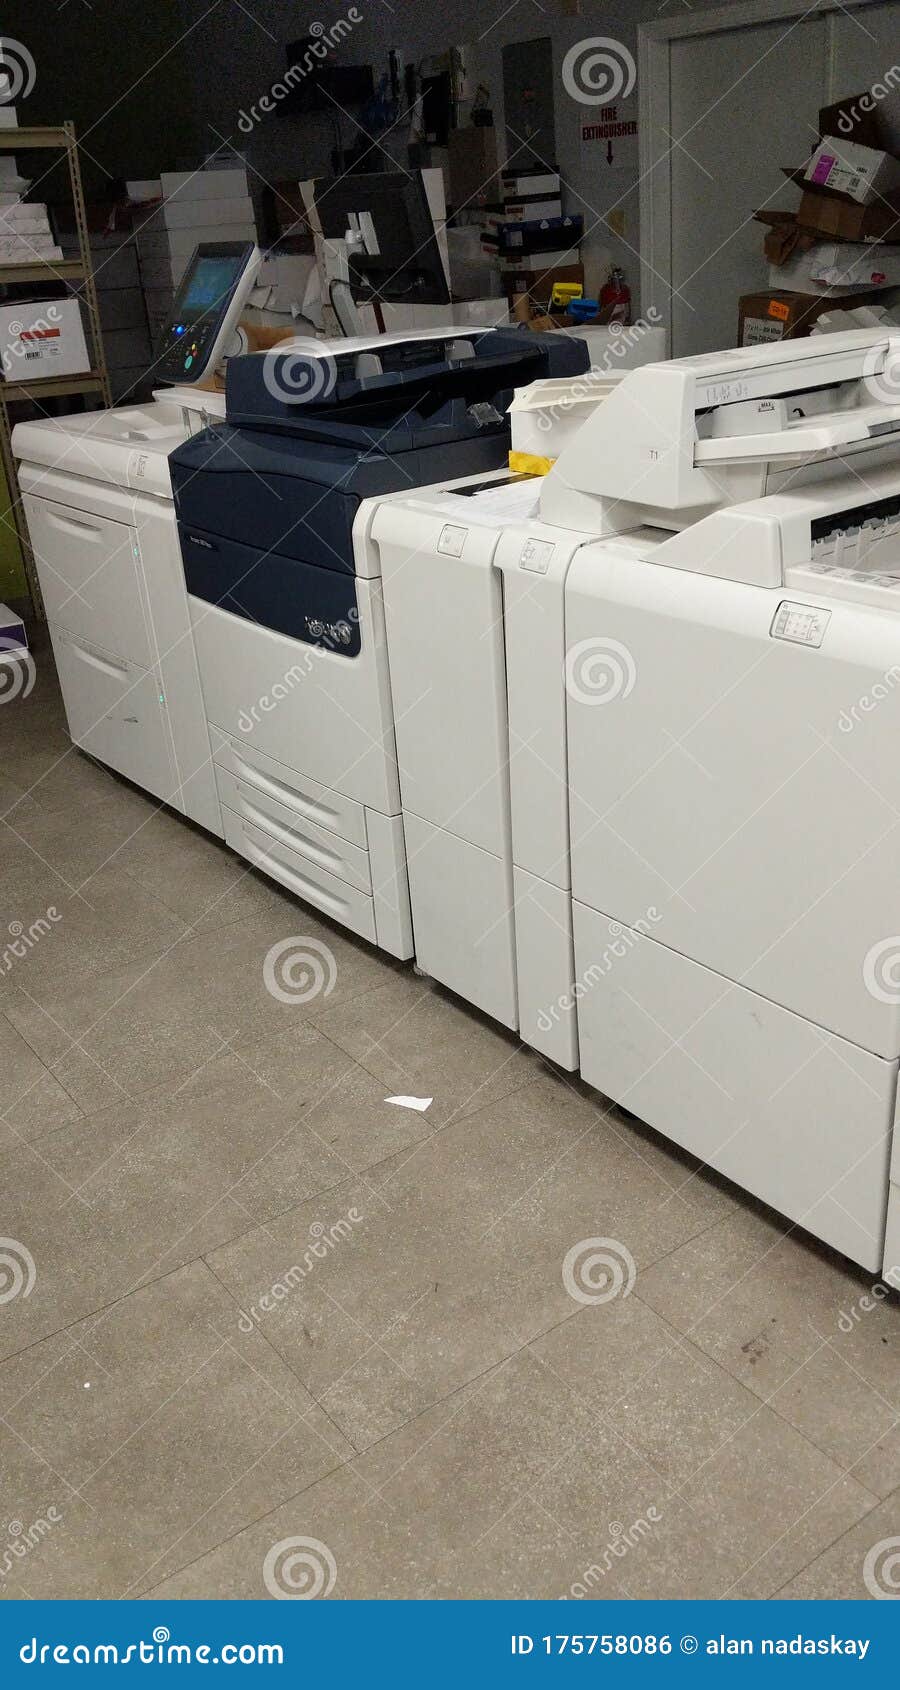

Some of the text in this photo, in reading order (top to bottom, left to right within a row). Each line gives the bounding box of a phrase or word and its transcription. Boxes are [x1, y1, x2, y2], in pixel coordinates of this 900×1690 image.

[601, 106, 617, 121] FIRE
[582, 121, 639, 141] EXTINGUISHER
[649, 449, 658, 460] T1
